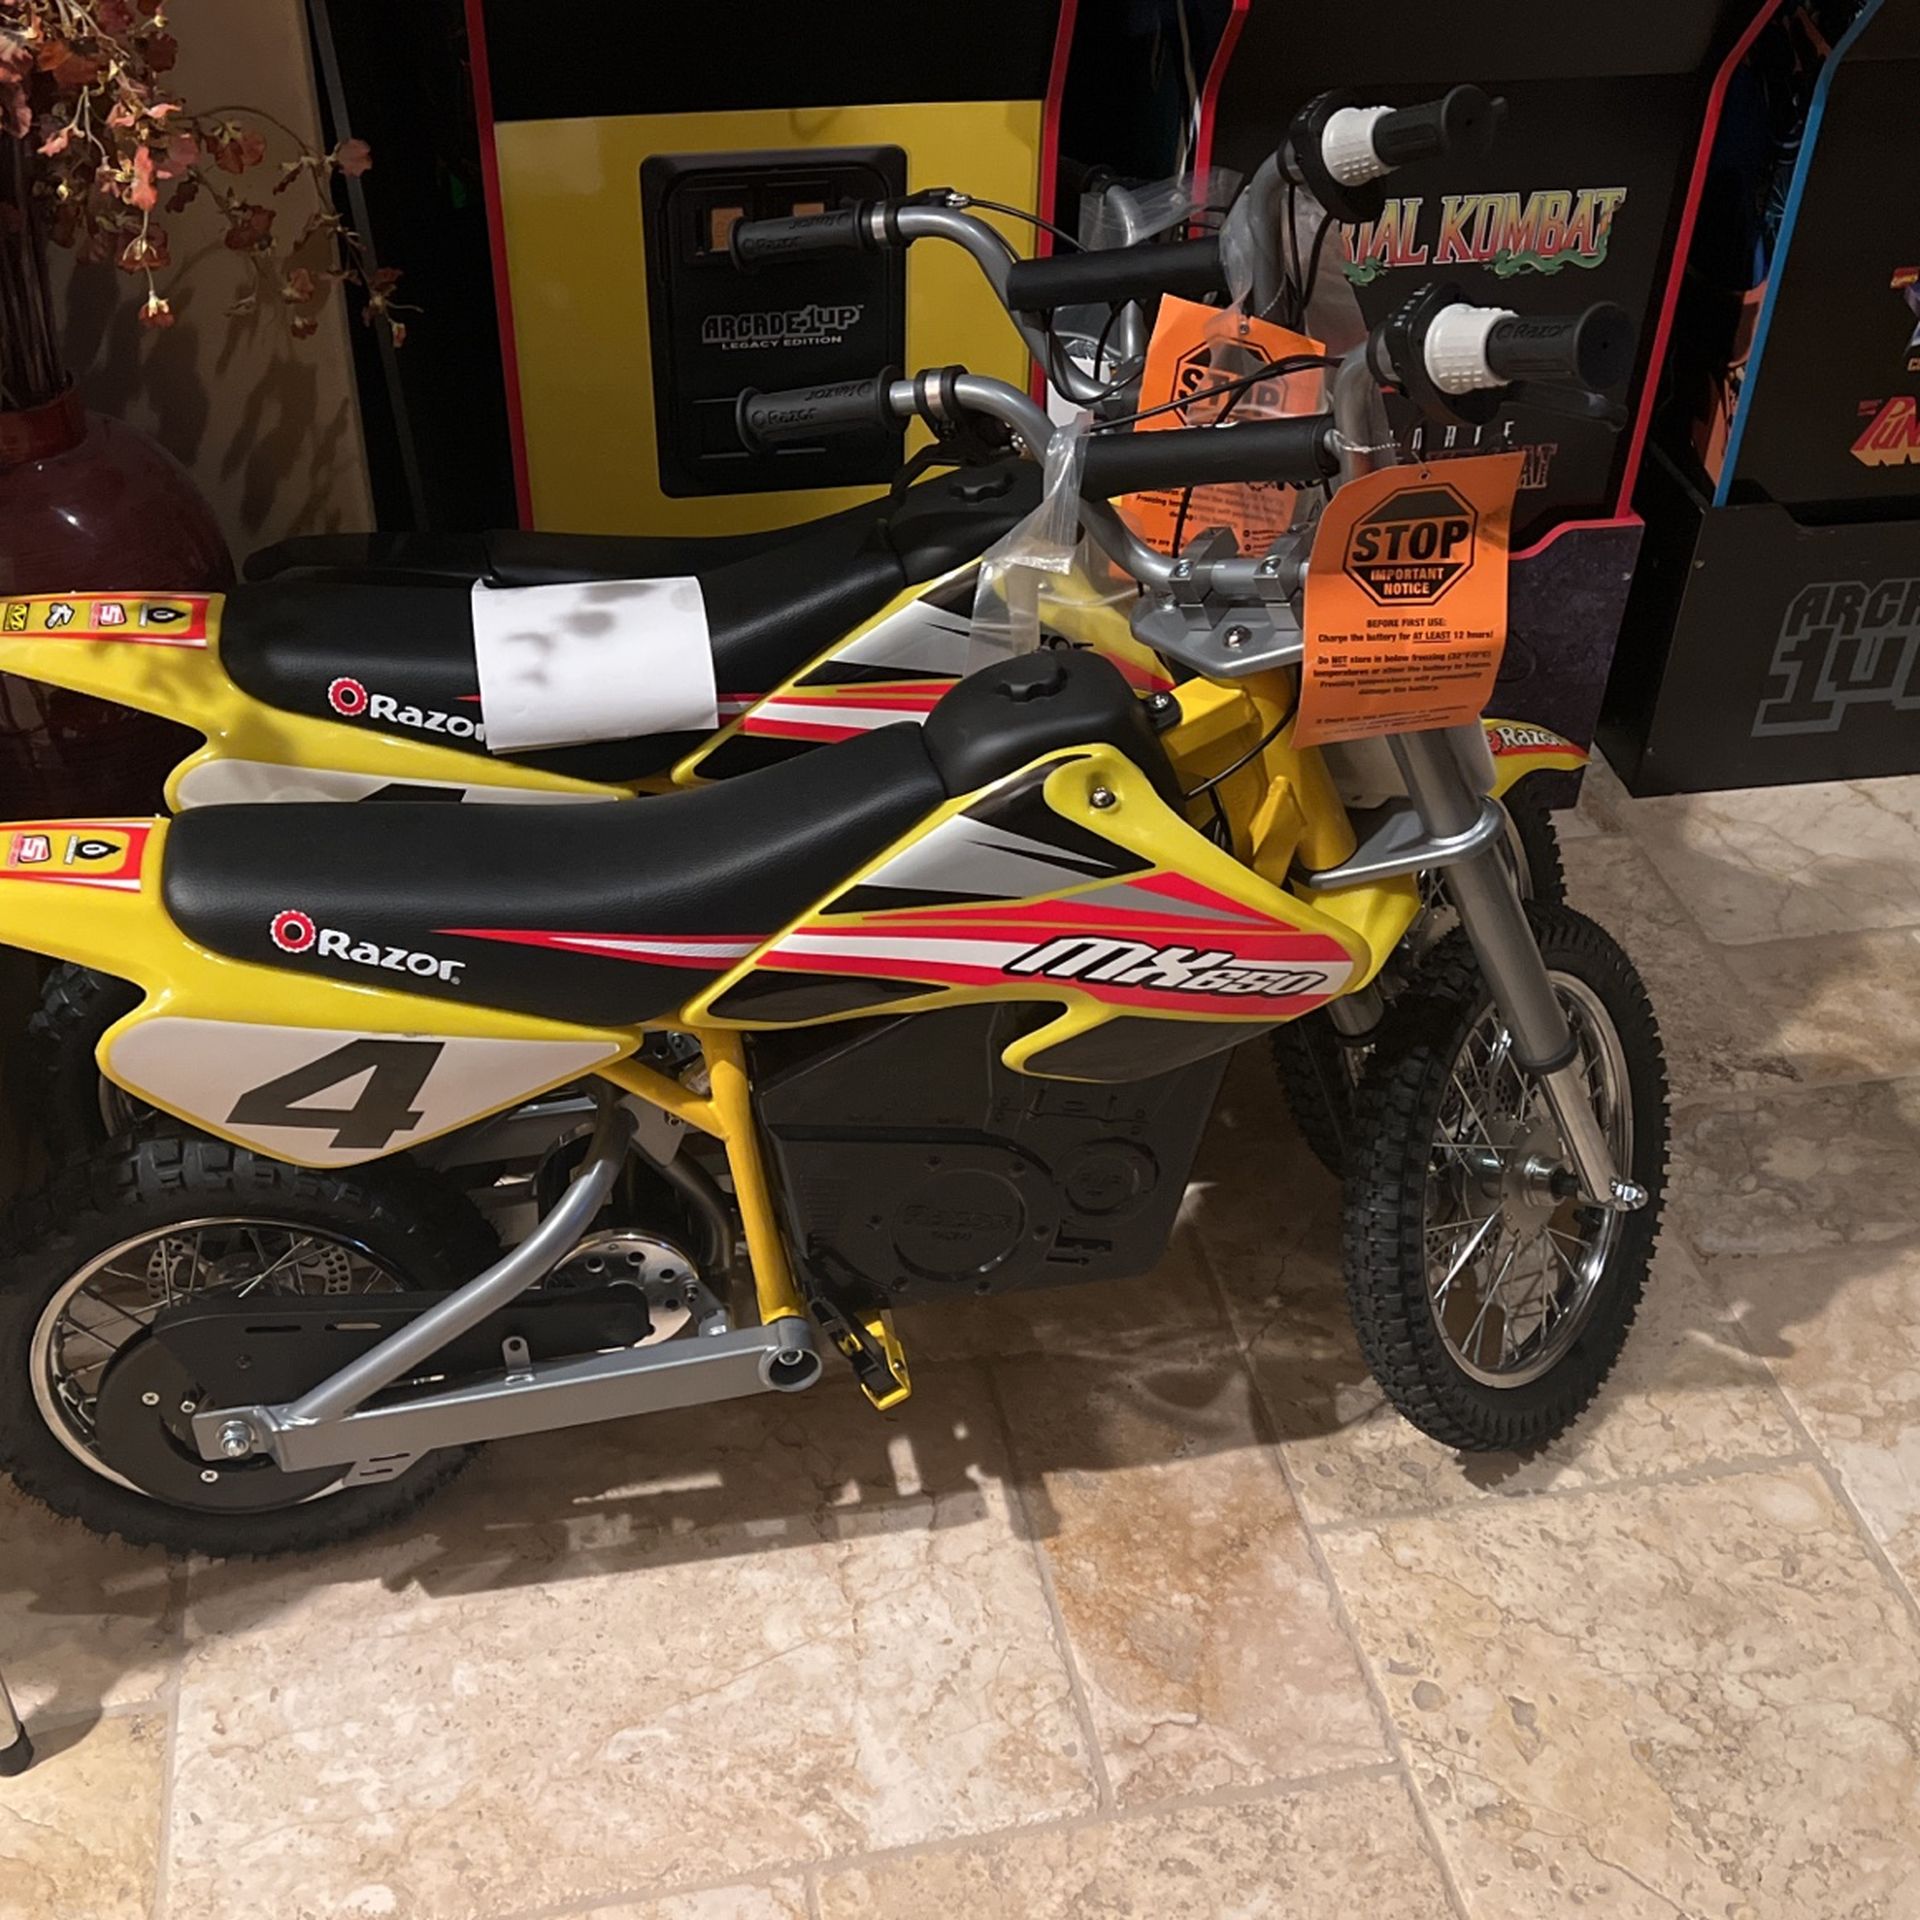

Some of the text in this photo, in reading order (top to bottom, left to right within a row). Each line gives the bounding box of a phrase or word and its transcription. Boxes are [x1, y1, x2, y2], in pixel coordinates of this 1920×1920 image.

[1433, 187, 1627, 264] KOMBAT
[722, 335, 842, 350] LEGACY EDITION
[1352, 520, 1470, 562] STOP
[1371, 568, 1444, 581] IMPORTANT
[1383, 582, 1430, 595] NOTICE
[1366, 619, 1398, 628] BEFORE
[1401, 618, 1425, 627] FIRST
[1318, 630, 1494, 643] Charge the battery for AT LEAST 12 hours!
[1318, 656, 1329, 665] Do
[1331, 656, 1348, 665] NOT
[1350, 655, 1372, 664] store
[1374, 655, 1382, 663] in
[1384, 654, 1409, 662] below
[1412, 653, 1446, 663] freezing
[317, 929, 465, 981] Razor
[1003, 935, 1327, 996] MX650
[226, 1039, 445, 1149] 4
